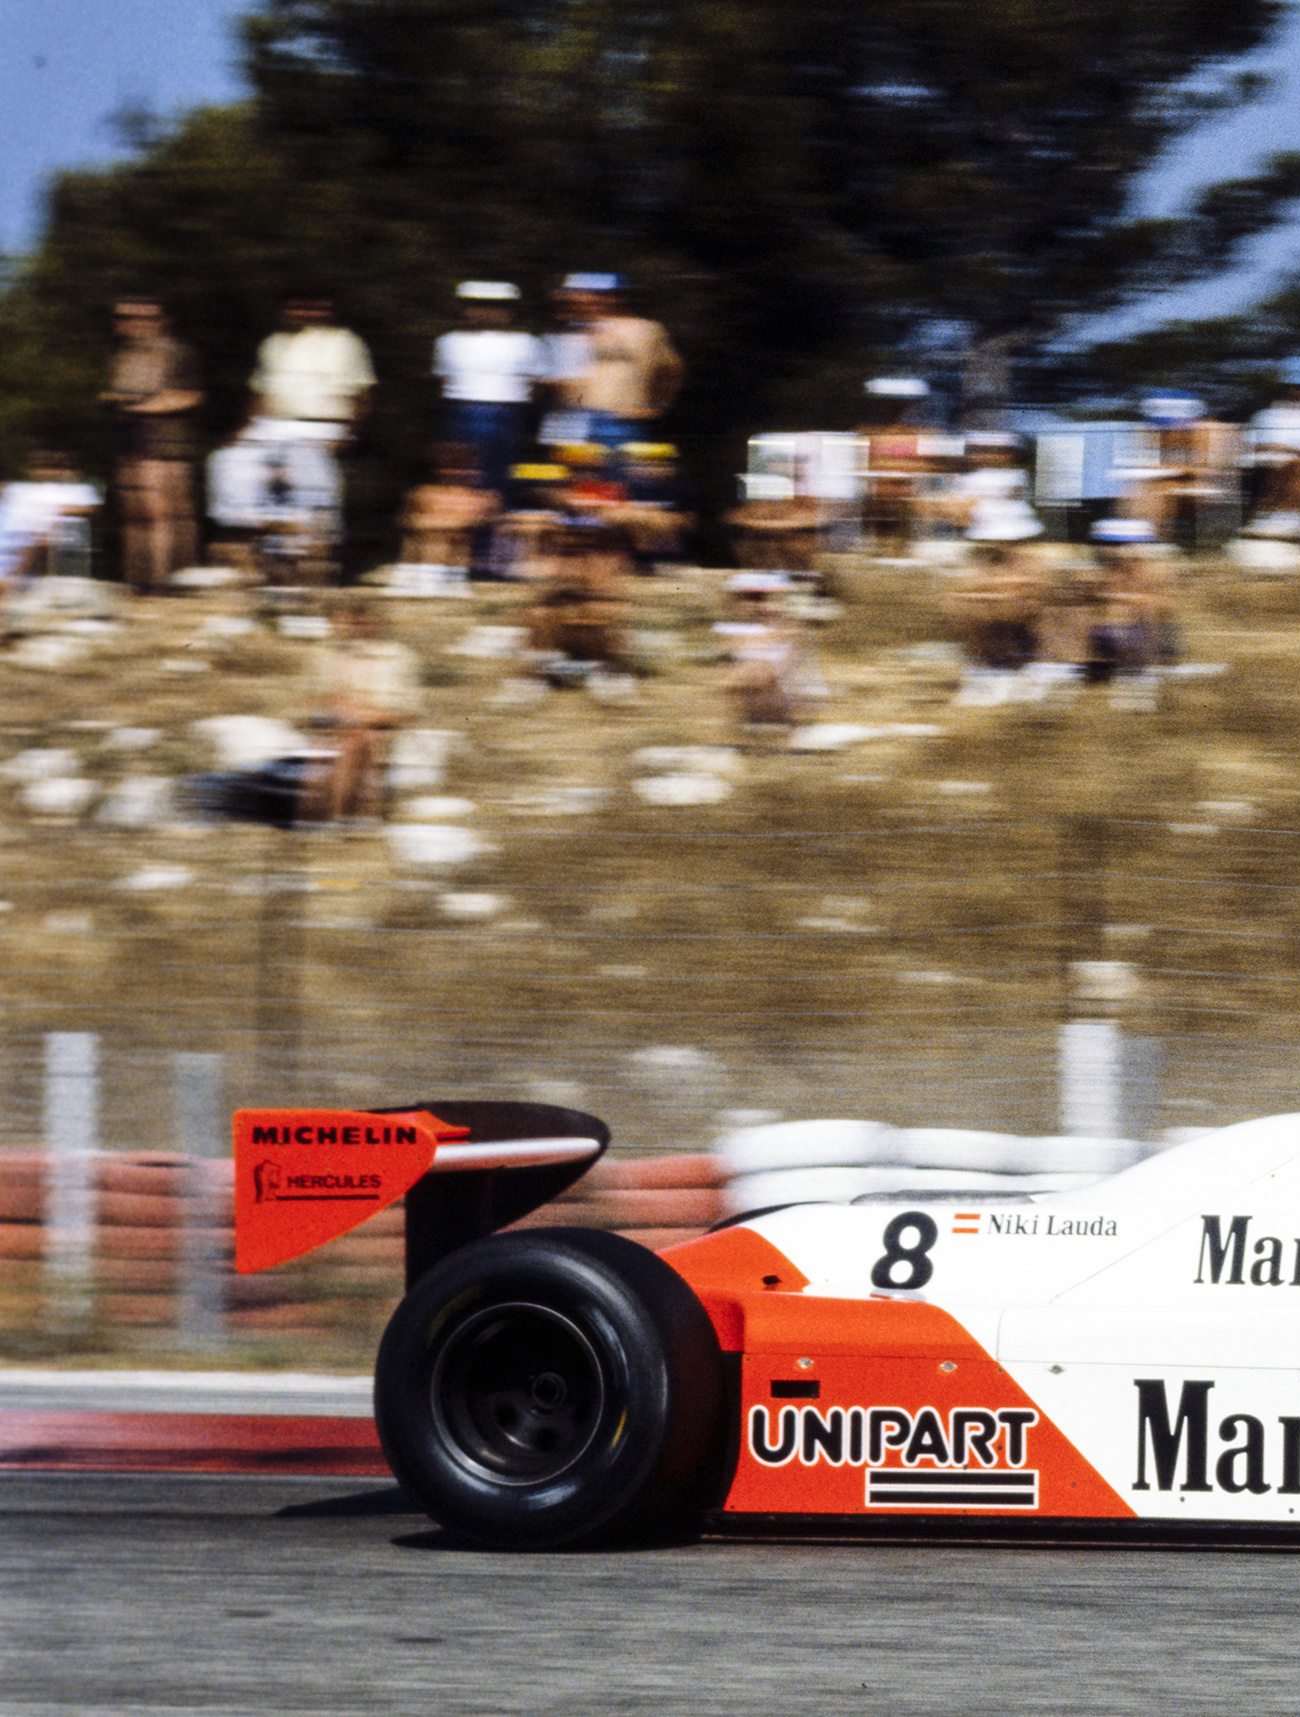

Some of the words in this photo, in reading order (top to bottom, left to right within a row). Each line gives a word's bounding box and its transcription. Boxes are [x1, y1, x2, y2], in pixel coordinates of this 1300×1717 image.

[252, 1127, 417, 1145] MICHELIN
[287, 1174, 382, 1189] HERCULES
[987, 1213, 1040, 1235] Niki
[1045, 1215, 1118, 1237] Lauda
[870, 1210, 939, 1290] 8
[749, 1405, 1040, 1467] UNIPART
